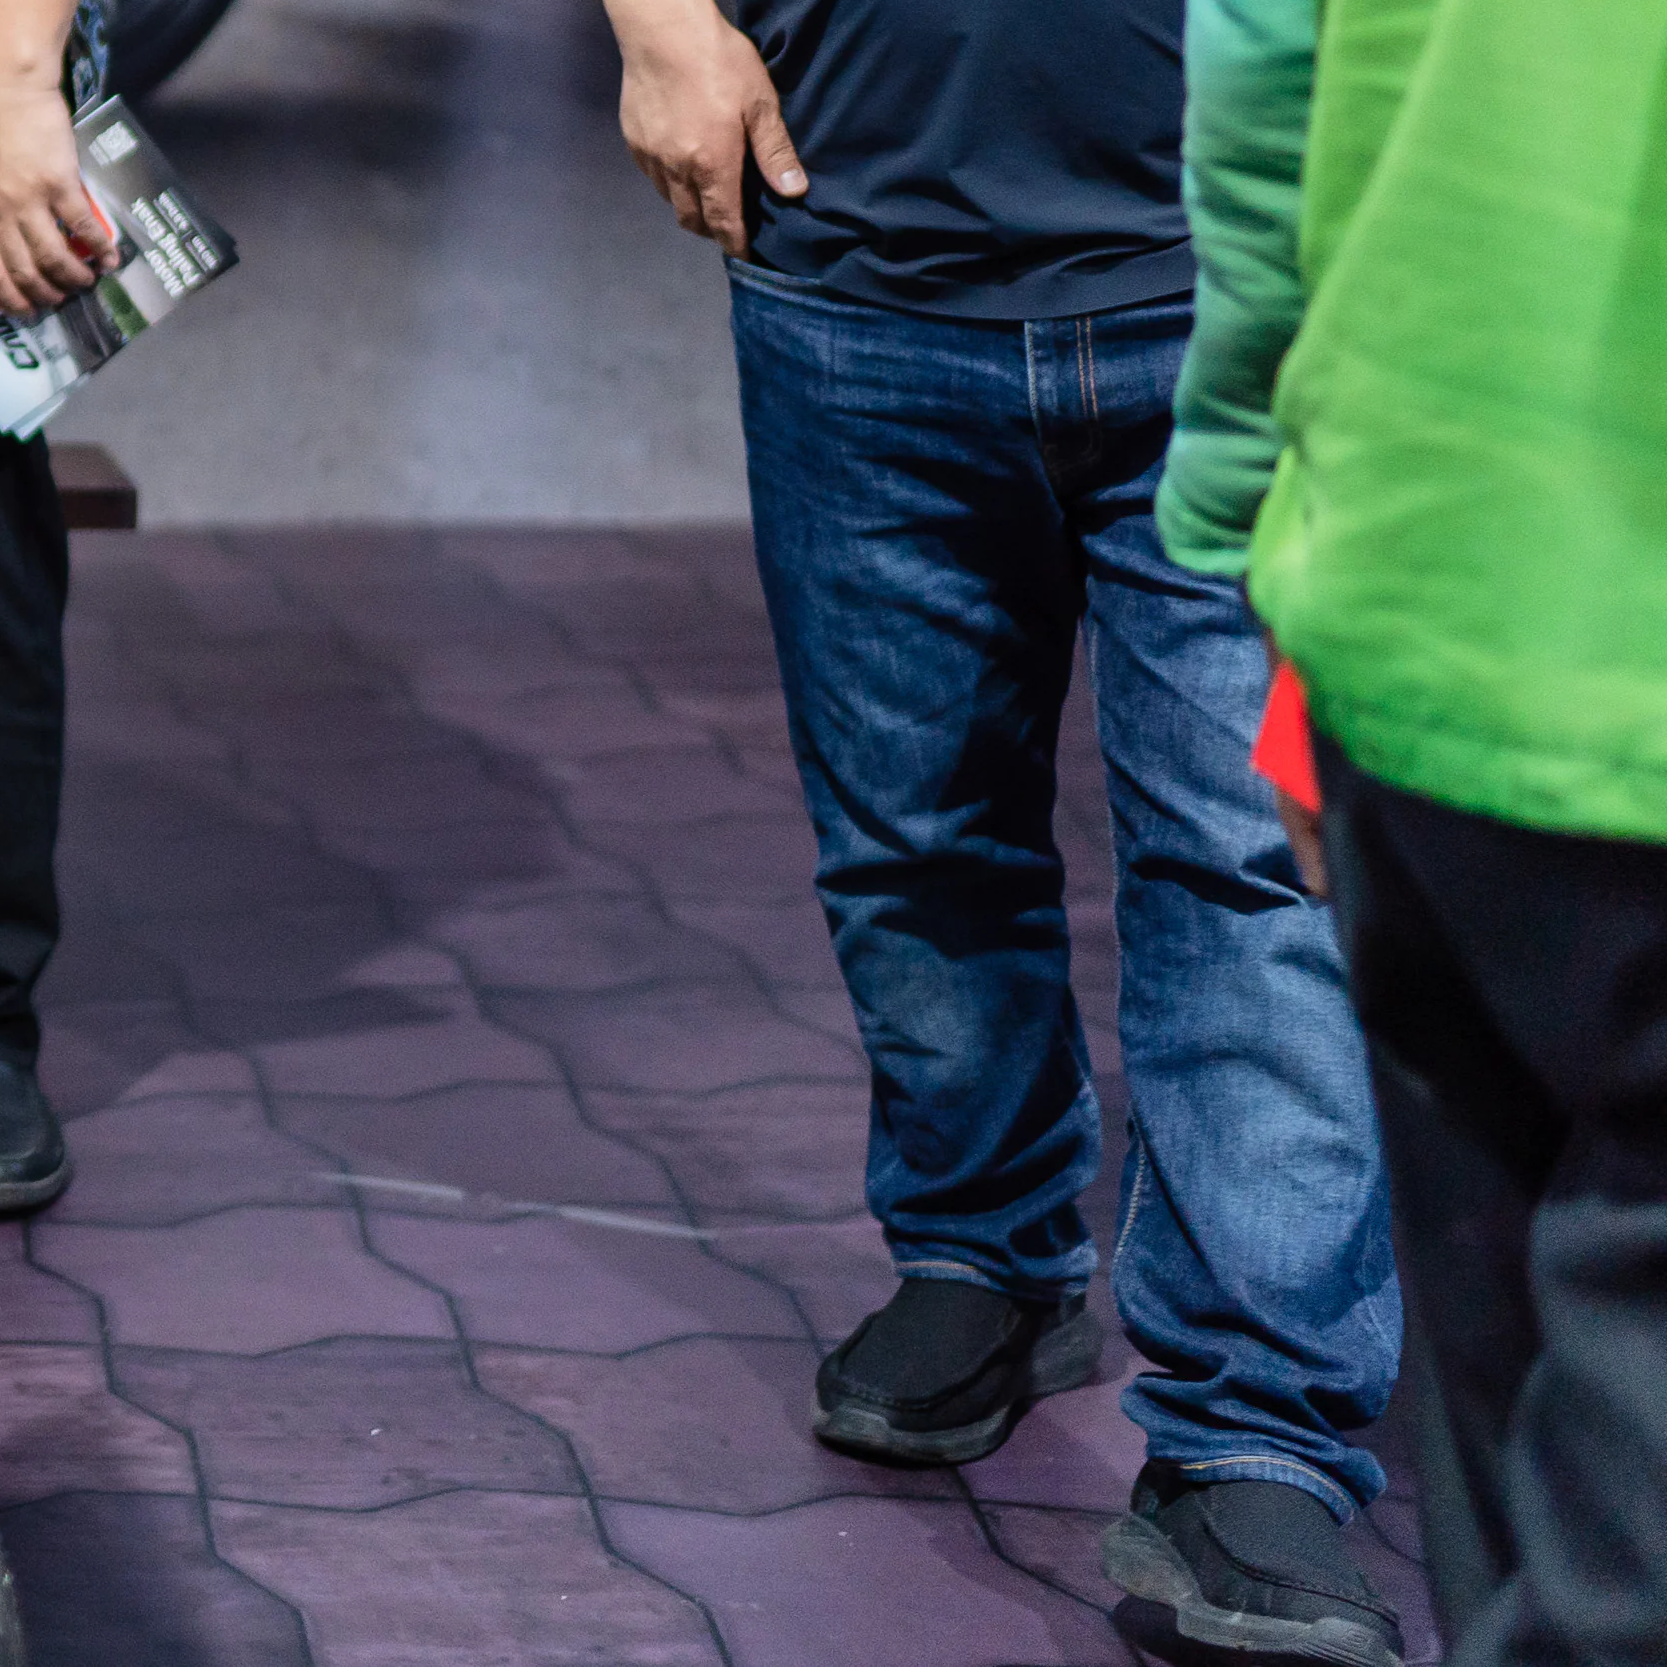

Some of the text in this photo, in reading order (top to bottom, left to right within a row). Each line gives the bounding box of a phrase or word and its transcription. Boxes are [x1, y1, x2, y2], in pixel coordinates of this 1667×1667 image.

[129, 195, 168, 242] Enak
[144, 248, 185, 298] Motor
[156, 231, 202, 289] Paling
